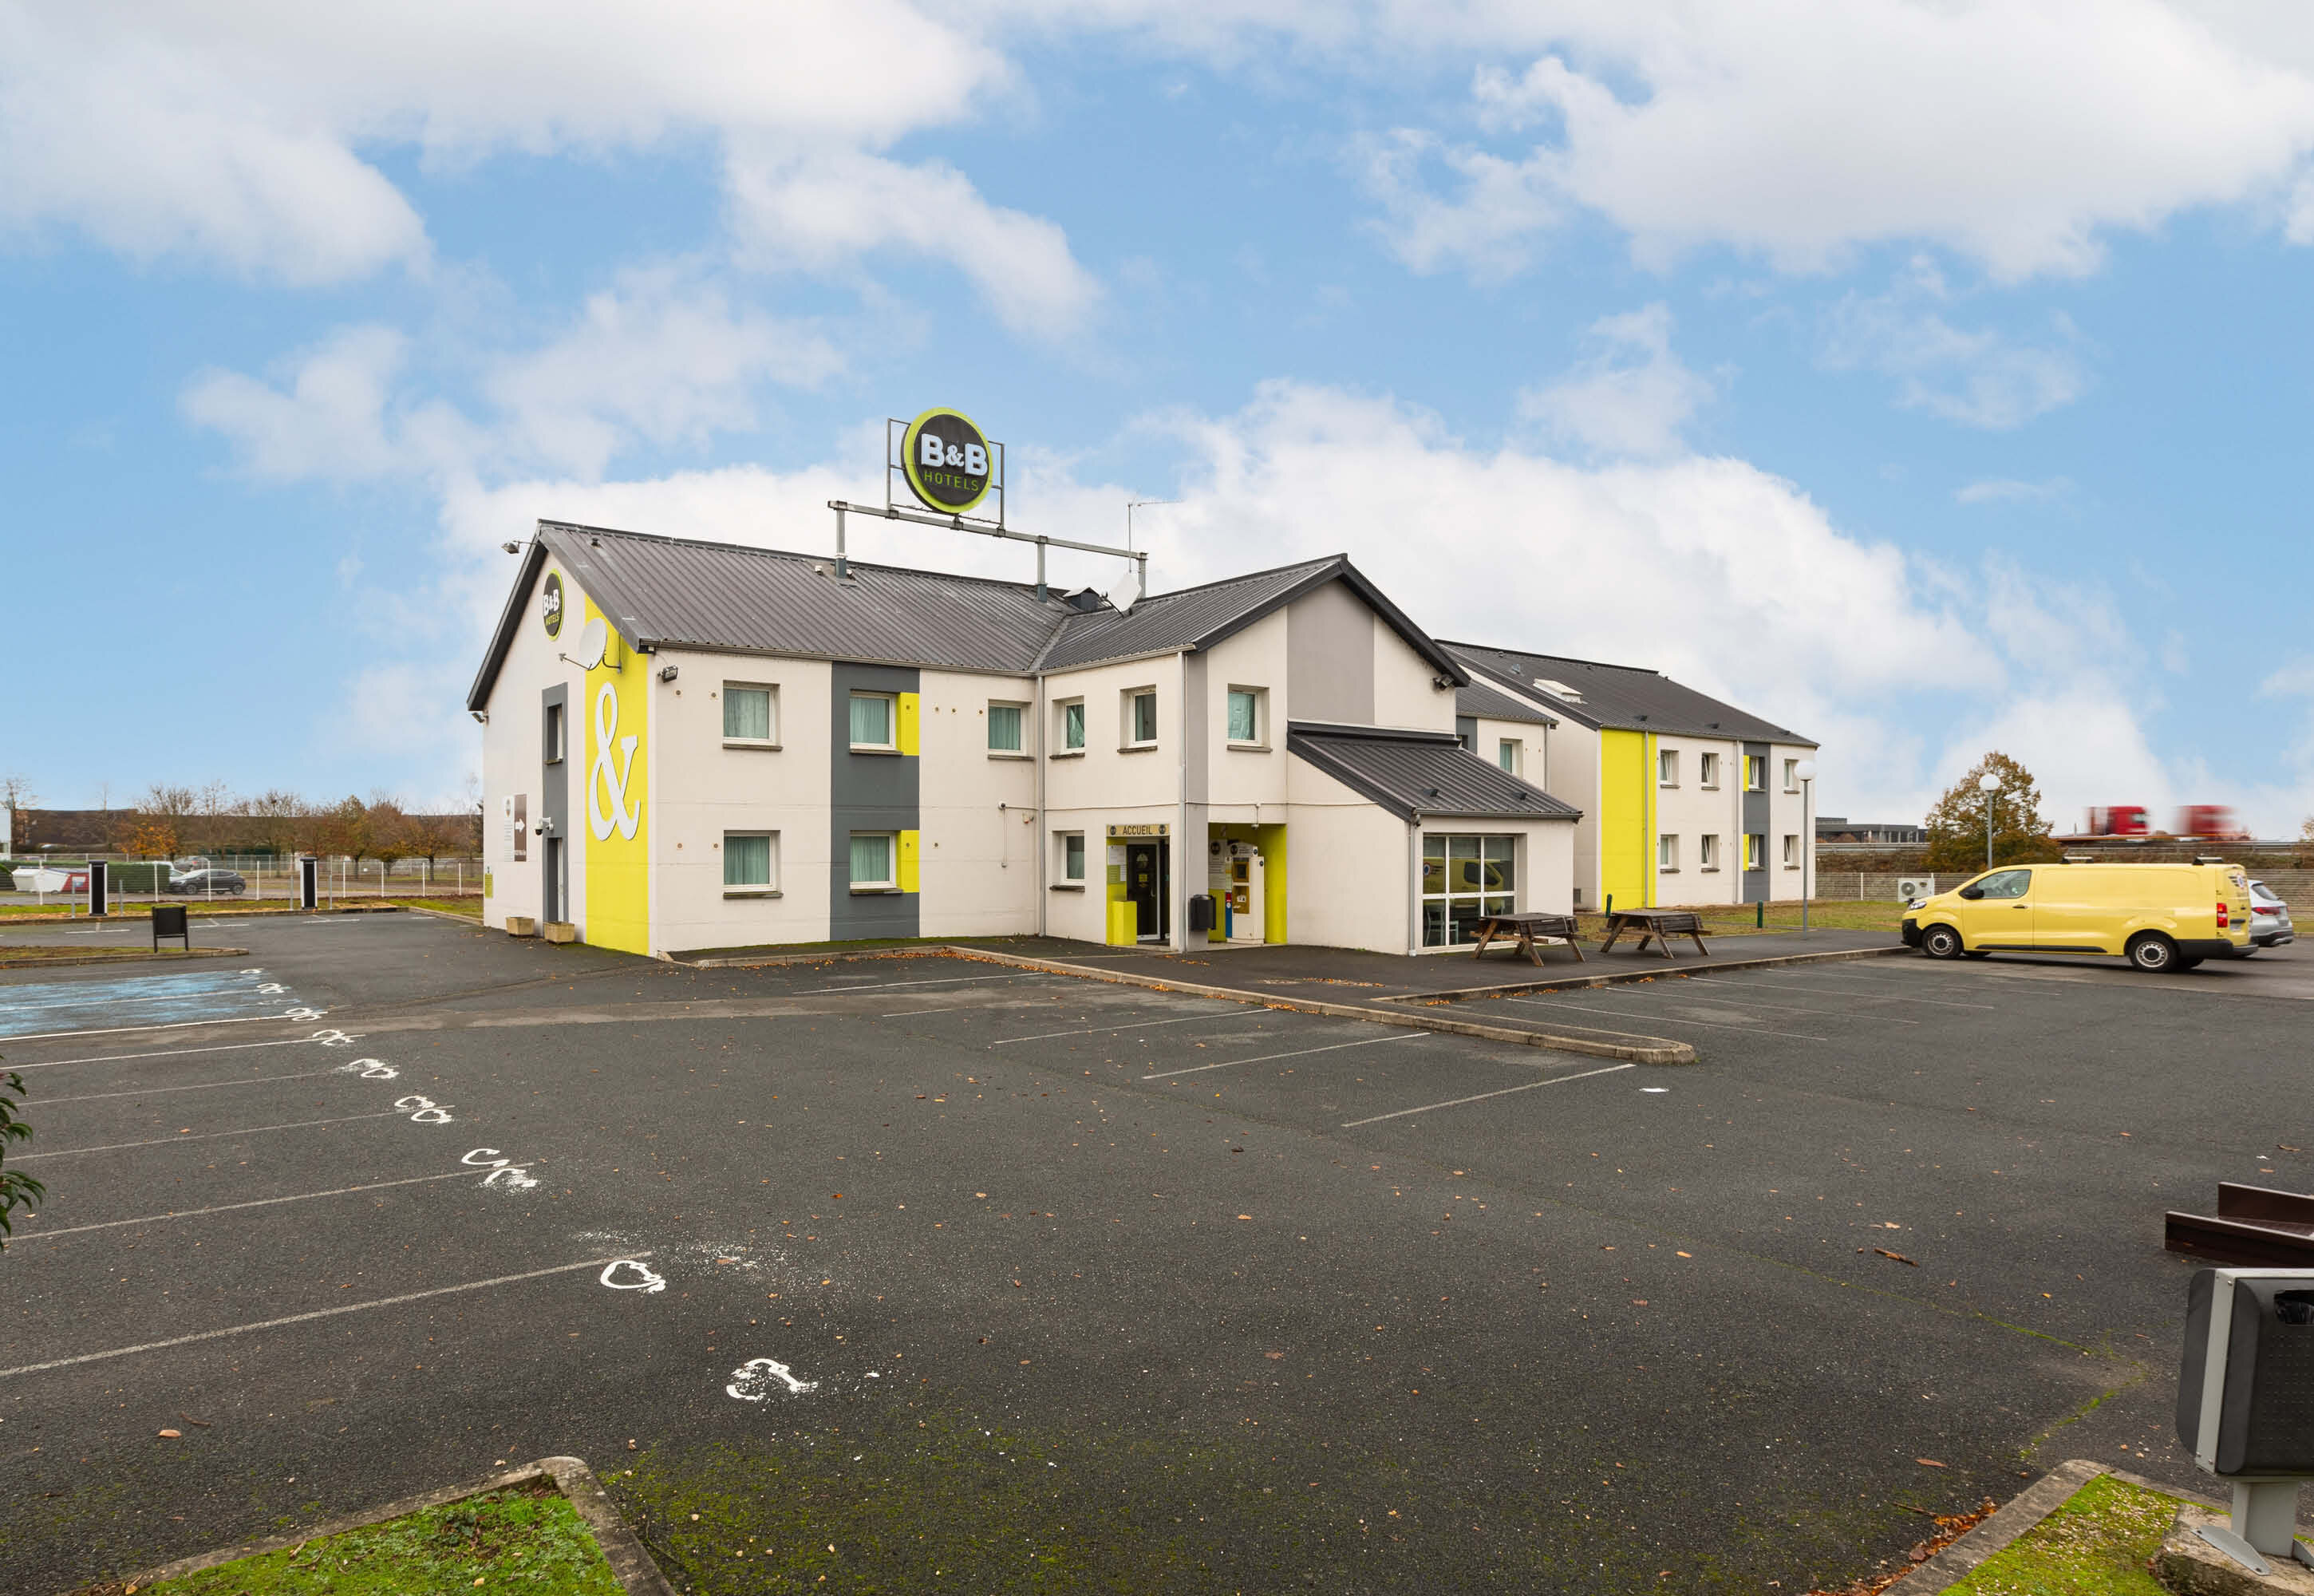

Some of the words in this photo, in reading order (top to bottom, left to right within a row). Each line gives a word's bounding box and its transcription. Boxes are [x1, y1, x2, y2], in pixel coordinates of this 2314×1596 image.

[921, 433, 988, 476] B&B
[923, 471, 979, 492] HOTELS
[543, 589, 559, 616] B&B
[589, 681, 641, 841] &
[1123, 824, 1153, 836] ACCUEIL
